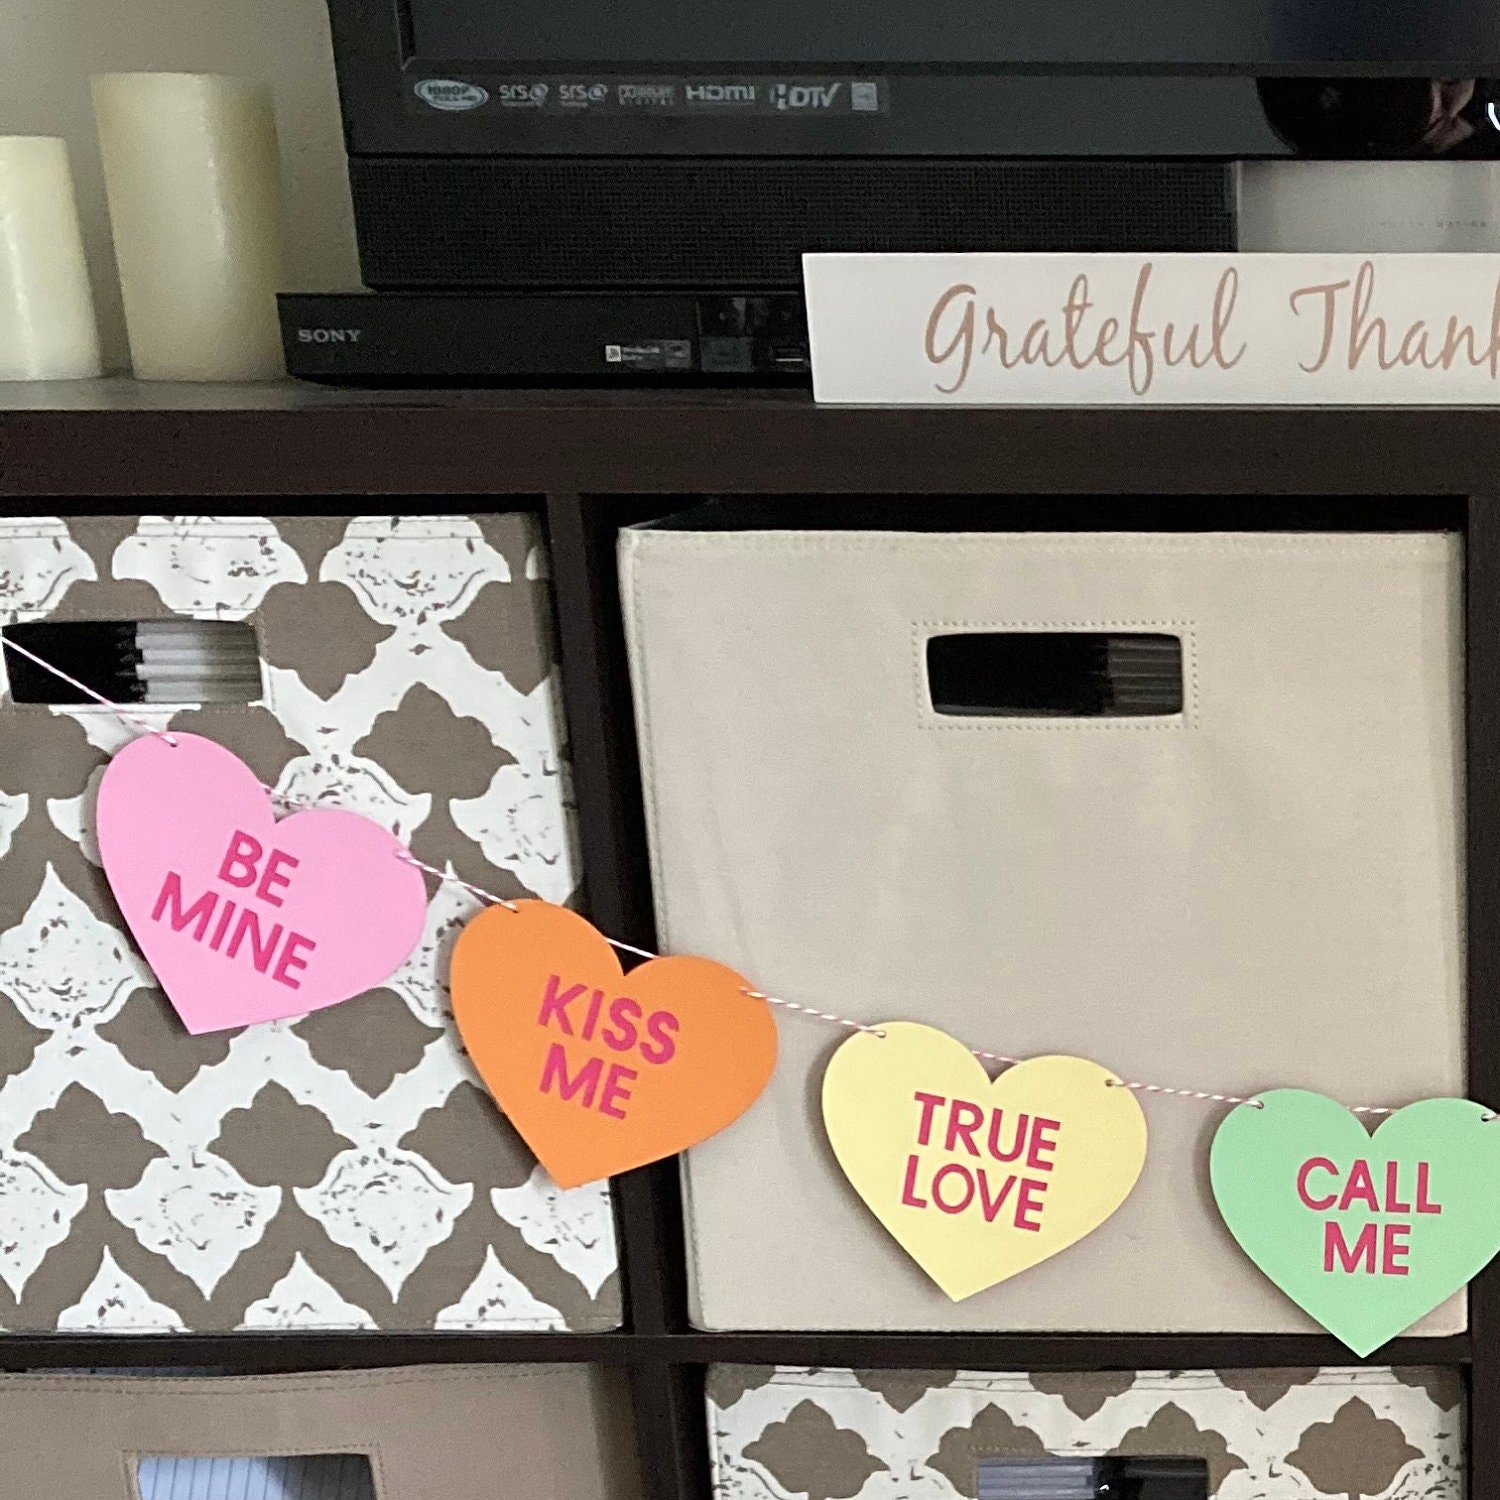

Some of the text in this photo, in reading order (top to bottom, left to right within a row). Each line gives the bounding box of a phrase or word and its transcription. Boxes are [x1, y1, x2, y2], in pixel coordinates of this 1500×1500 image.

[298, 328, 361, 343] SONY
[924, 262, 1247, 395] Grateful
[217, 829, 300, 908] BE
[151, 870, 317, 990] MINE
[537, 974, 680, 1065] KISS
[539, 1042, 638, 1120] ME
[914, 1091, 1062, 1172] TRUE
[901, 1154, 1049, 1233] LOVE
[1296, 1156, 1442, 1215] CALL
[1323, 1220, 1411, 1276] ME
